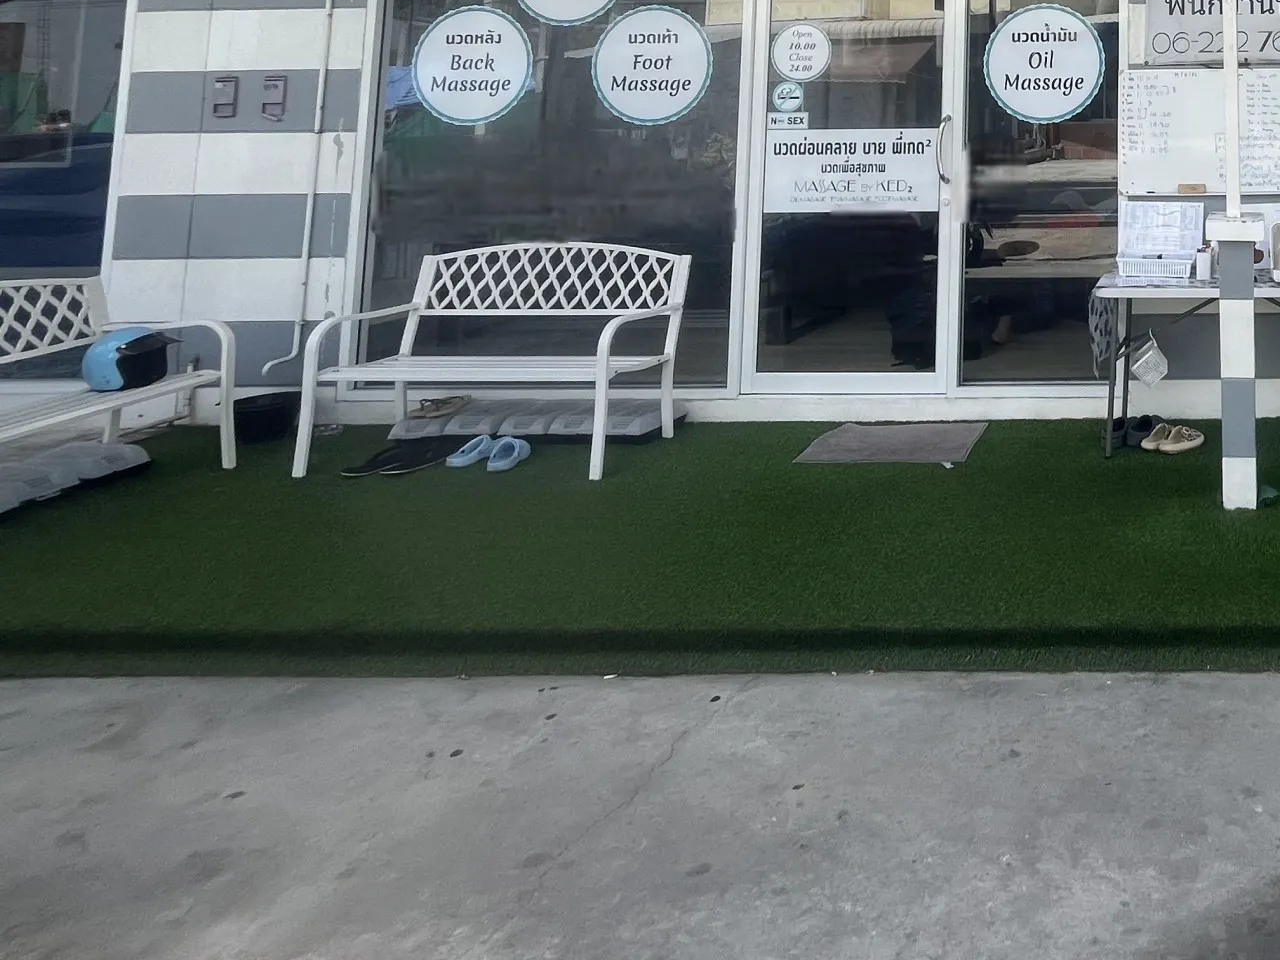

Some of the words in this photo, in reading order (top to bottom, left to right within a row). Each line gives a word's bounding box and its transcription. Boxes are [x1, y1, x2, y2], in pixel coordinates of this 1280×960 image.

[445, 30, 502, 45] นวดหลัง
[628, 29, 679, 44] นวดเท้า
[792, 29, 812, 39] Open
[1012, 23, 1078, 43] นวดน้ำมัน
[788, 42, 816, 50] 10.00
[450, 53, 495, 71] Back
[632, 55, 672, 70] Foot
[788, 53, 813, 61] Close
[1028, 50, 1054, 69] Oil
[788, 64, 813, 72] 24.00
[431, 76, 511, 97] Massage
[611, 76, 691, 97] Massage
[1004, 74, 1084, 96] Massage
[787, 116, 805, 125] SEX
[773, 137, 857, 156] นวดผ่อนคลาย
[863, 141, 886, 155] บาย
[821, 156, 886, 177] นวดเพื่อสุขภาพ
[794, 179, 856, 193] MASSAGE
[860, 184, 874, 192] BY
